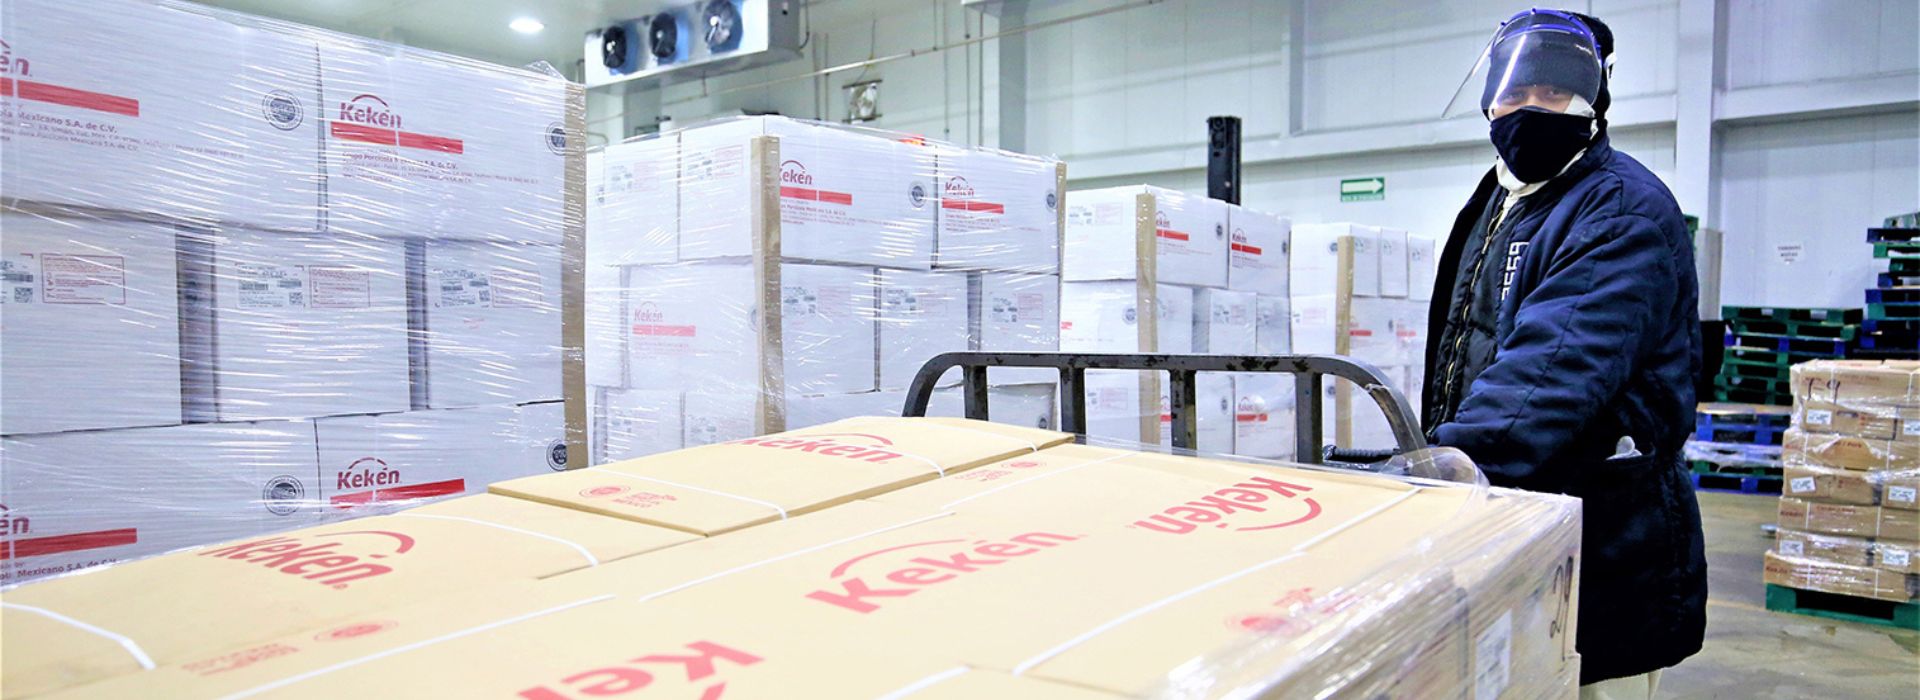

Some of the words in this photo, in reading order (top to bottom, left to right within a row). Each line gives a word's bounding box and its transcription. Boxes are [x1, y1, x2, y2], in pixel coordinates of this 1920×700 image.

[337, 468, 401, 490] Kekén
[1132, 476, 1314, 535] Kekén
[17, 565, 64, 578] Mexicano
[198, 536, 394, 586] Kekén
[804, 531, 1081, 614] Kekén
